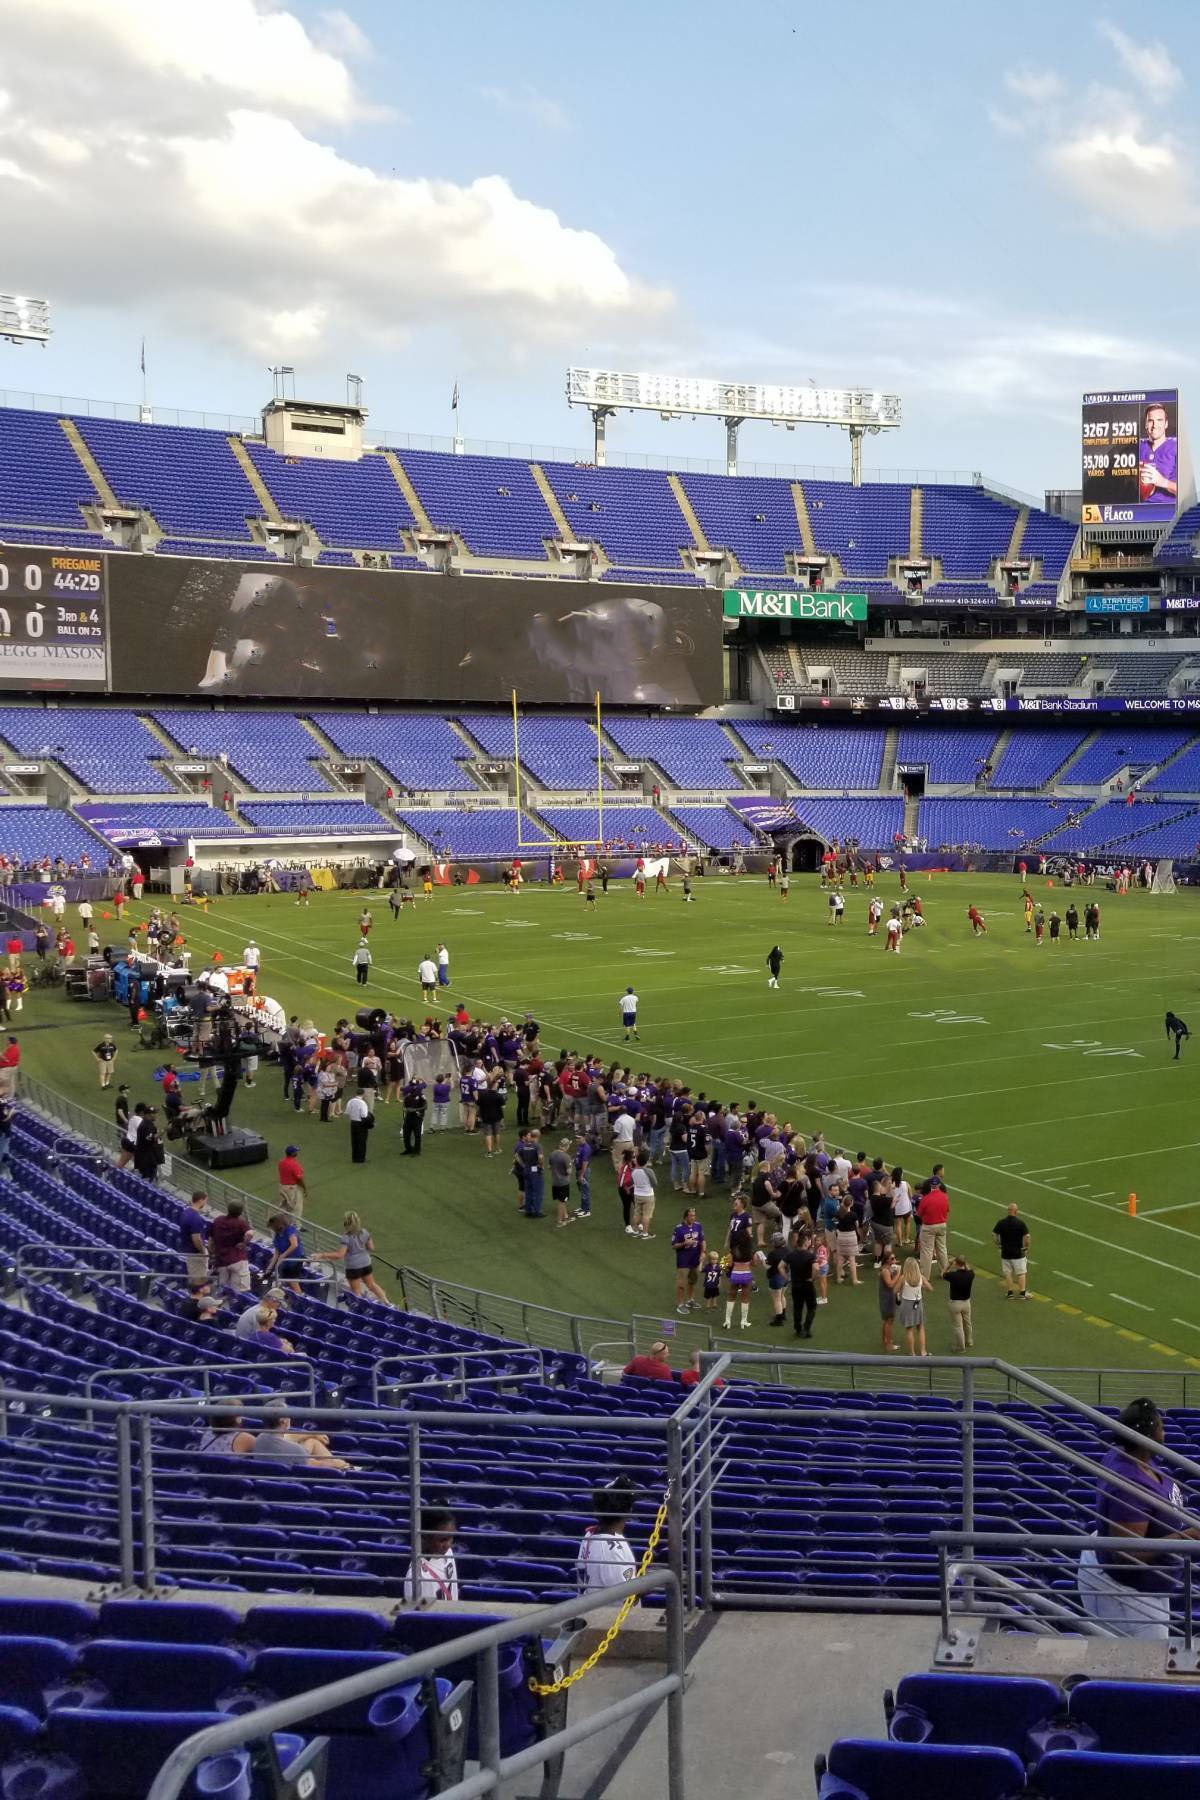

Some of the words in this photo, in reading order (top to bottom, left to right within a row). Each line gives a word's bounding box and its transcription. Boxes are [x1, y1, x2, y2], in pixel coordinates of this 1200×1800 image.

[1083, 422, 1109, 438] 3267
[1112, 421, 1137, 437] 5291
[1113, 454, 1136, 468] 200
[1085, 507, 1092, 521] 5
[1104, 510, 1134, 521] FLACCO
[52, 557, 101, 571] PREGAME
[25, 564, 42, 591] 0
[53, 572, 100, 592] 44:29
[738, 592, 797, 616] M&T
[800, 594, 854, 618] Bank
[1166, 599, 1186, 609] M&T
[57, 606, 77, 622] 3RD
[80, 612, 87, 623] &
[90, 608, 98, 623] 4
[26, 611, 43, 637] 0
[57, 625, 77, 635] BALL
[79, 626, 89, 636] ON
[92, 627, 101, 636] 25
[43, 647, 104, 660] MASON
[1019, 701, 1041, 710] M&T
[1042, 700, 1062, 710] Bank
[1064, 700, 1097, 710] Stadium
[1125, 700, 1170, 709] WELCOME
[1173, 700, 1186, 709] TO
[907, 1009, 981, 1024] 30
[1041, 1040, 1135, 1056] 20
[690, 1134, 696, 1148] 5
[707, 1272, 717, 1281] 57
